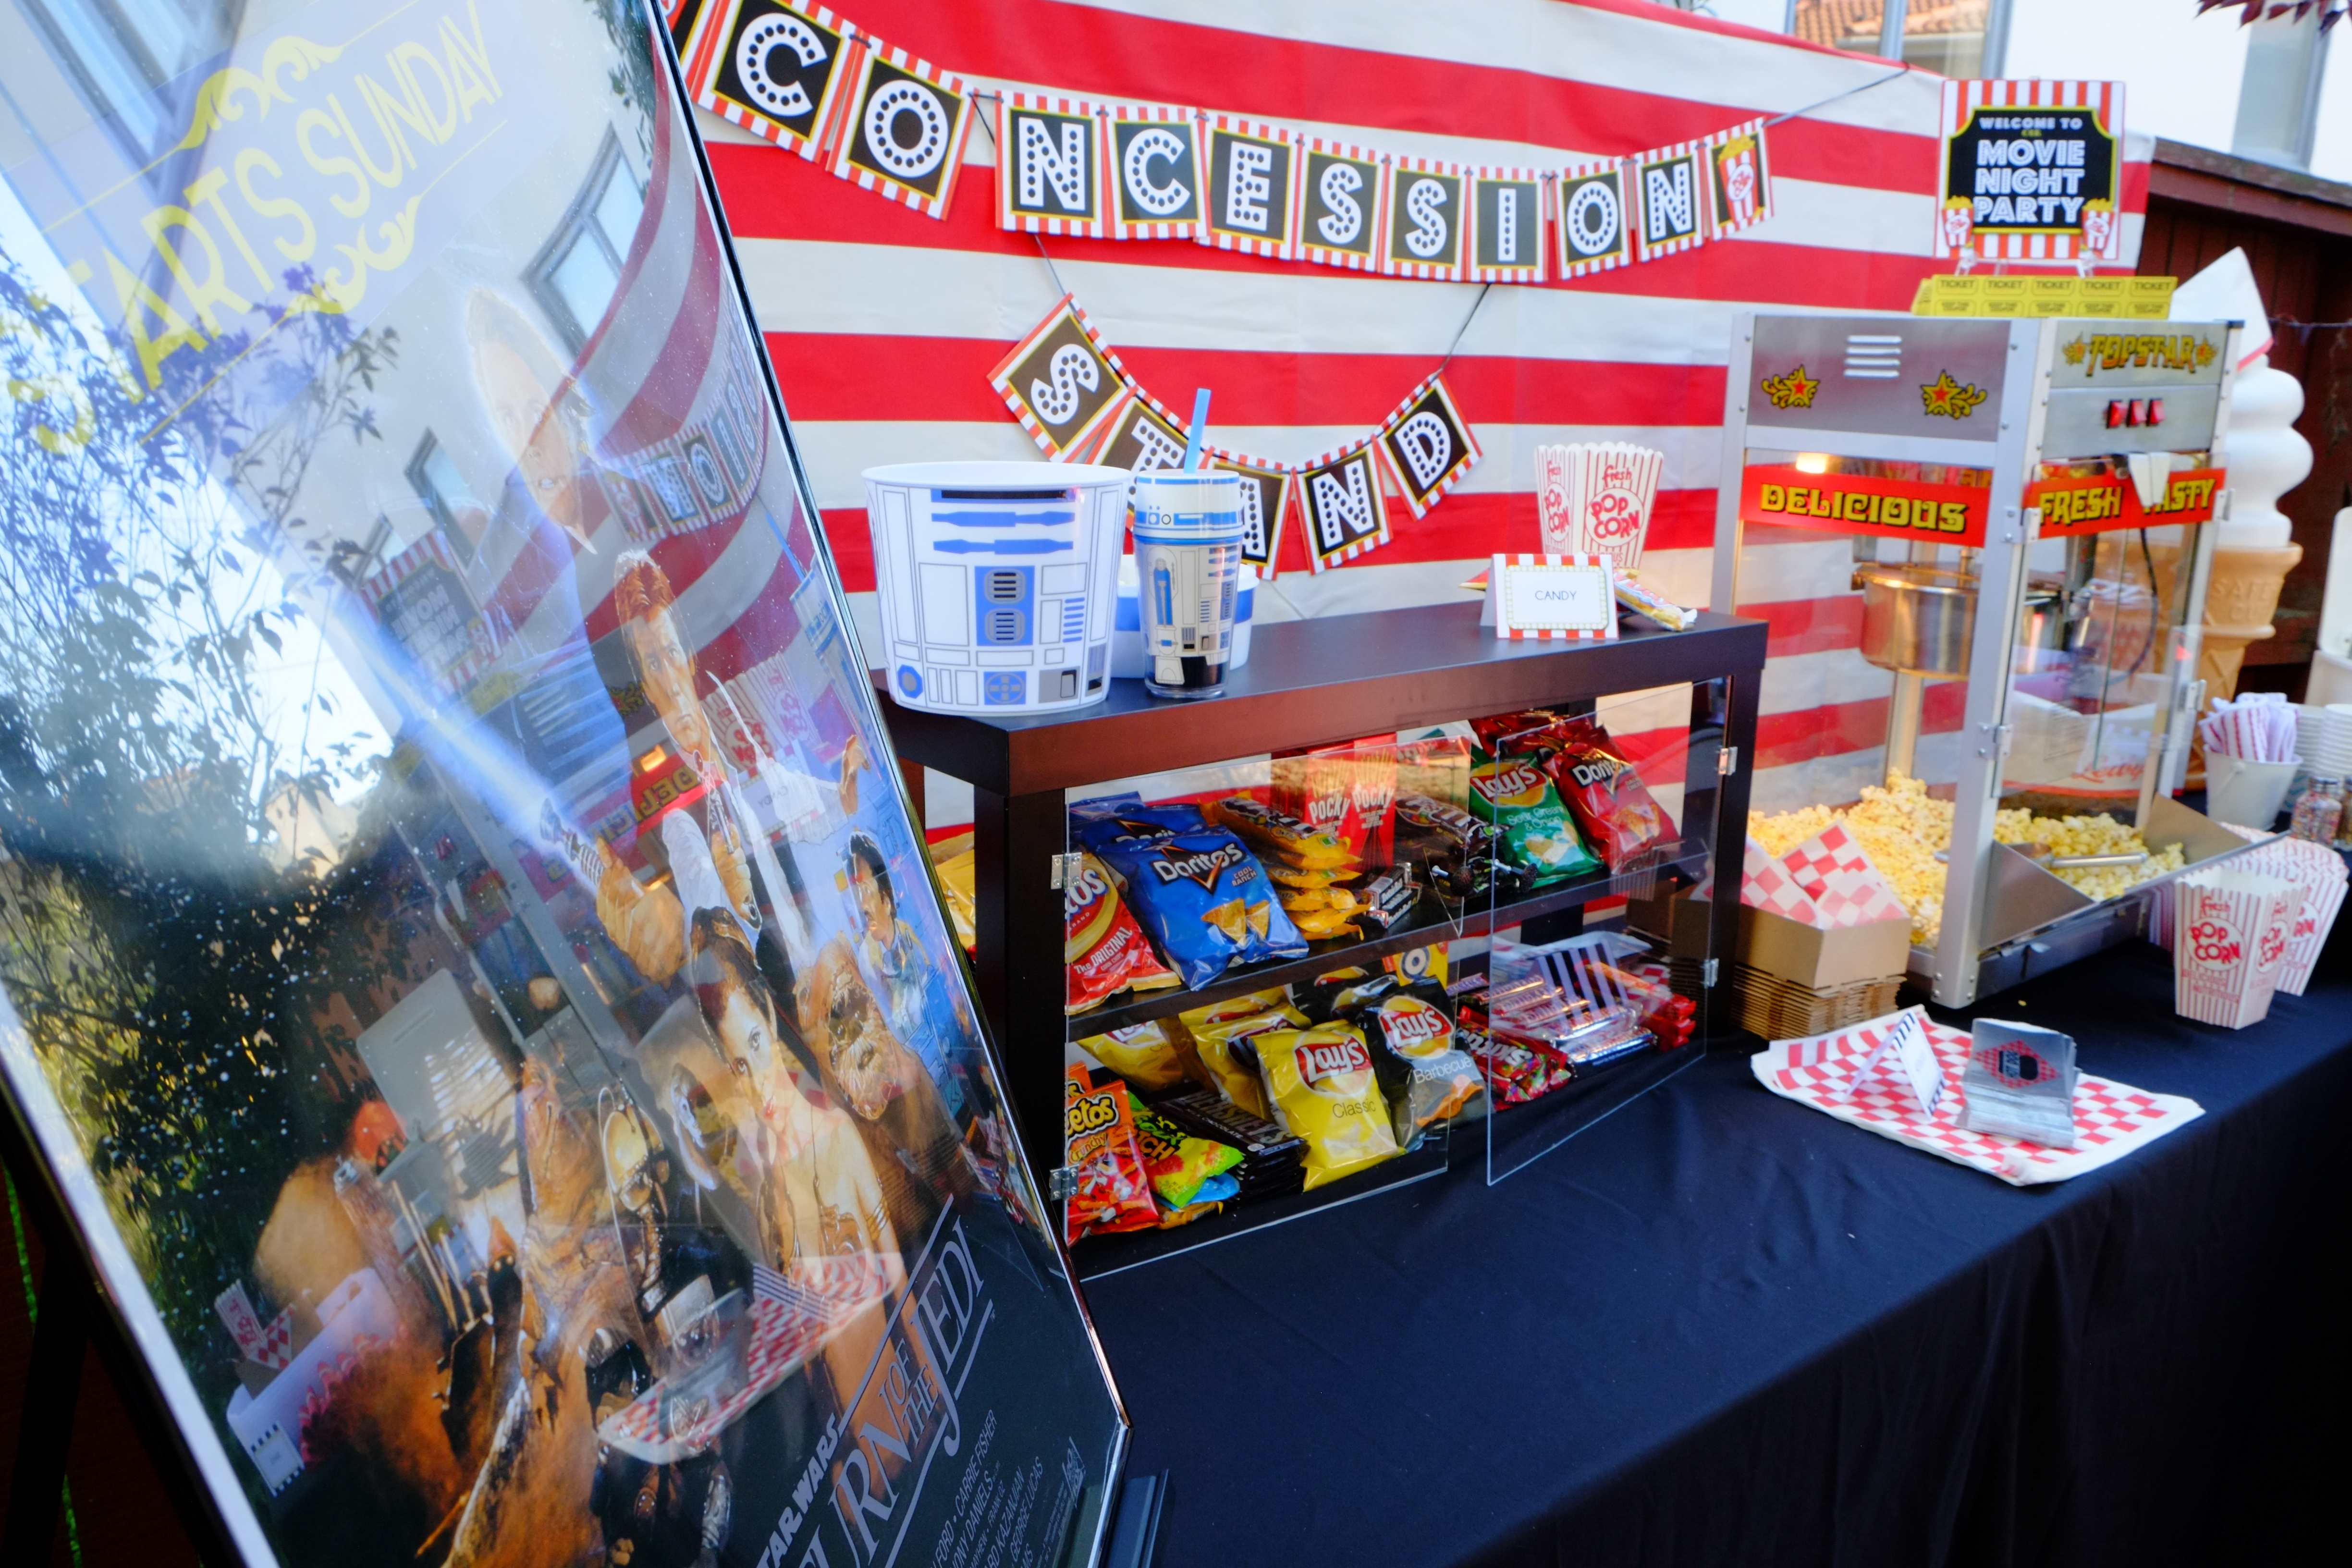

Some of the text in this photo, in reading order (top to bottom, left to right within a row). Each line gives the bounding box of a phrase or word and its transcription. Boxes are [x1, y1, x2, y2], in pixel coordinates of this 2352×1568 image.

[296, 0, 503, 218] SUNDAY
[1979, 117, 2083, 130] WELCOME TO
[736, 13, 1694, 257] CONCESSION
[1977, 139, 2085, 166] MOVIE
[1975, 168, 2085, 195] NIGHT
[1973, 196, 2085, 223] PARTY
[1940, 280, 2171, 291] TICKET TICKET TICKET TICKET TICKET
[2086, 333, 2196, 377] TOPSTAR
[1602, 465, 1632, 488] fresh
[1544, 489, 1562, 511] POP
[1591, 493, 1629, 522] POP
[1760, 483, 1967, 533] DELICIOUS
[2040, 479, 2216, 525] FRESH ASTY
[1549, 505, 1570, 534] CORN
[1594, 510, 1640, 539] CORN
[1535, 591, 1577, 601] CANDY
[1472, 765, 1537, 797] Lay's
[1309, 793, 1350, 824] POCKY
[1351, 782, 1395, 813] POCKY
[1507, 806, 1565, 825] Sour Cream
[1524, 816, 1562, 831] & Onion
[1153, 843, 1243, 882] Doritos
[1233, 865, 1253, 879] COOL
[1231, 870, 1257, 887] RANCH
[2189, 921, 2229, 945] POP
[1074, 926, 1133, 975] The ORIGINAL
[2194, 941, 2242, 964] CORN
[1384, 1008, 1442, 1048] Lay's
[1301, 1040, 1365, 1083] Lay's
[1413, 1057, 1472, 1084] Barbecue
[1176, 1090, 1297, 1144] HERSHEYS
[1333, 1099, 1376, 1118] Classic
[1202, 1117, 1244, 1139] CHOCOLATE
[1069, 1131, 1107, 1164] Crunchy
[1137, 1129, 1176, 1162] TCH
[911, 1214, 984, 1457] JEDI
[887, 1338, 917, 1406] OF
[901, 1364, 940, 1449] THE
[756, 1412, 838, 1568] TAR WARS
[936, 1520, 954, 1564] FORD
[955, 1455, 980, 1517] CARRIE
[975, 1409, 997, 1465] FISHER
[966, 1470, 993, 1541] DANIELS
[988, 1496, 1001, 1528] FRANK
[999, 1480, 1005, 1498] OZ
[996, 1466, 1025, 1553] KAZANJIAN
[1010, 1499, 1029, 1562] GEORGE
[1027, 1456, 1044, 1509] LUCAS
